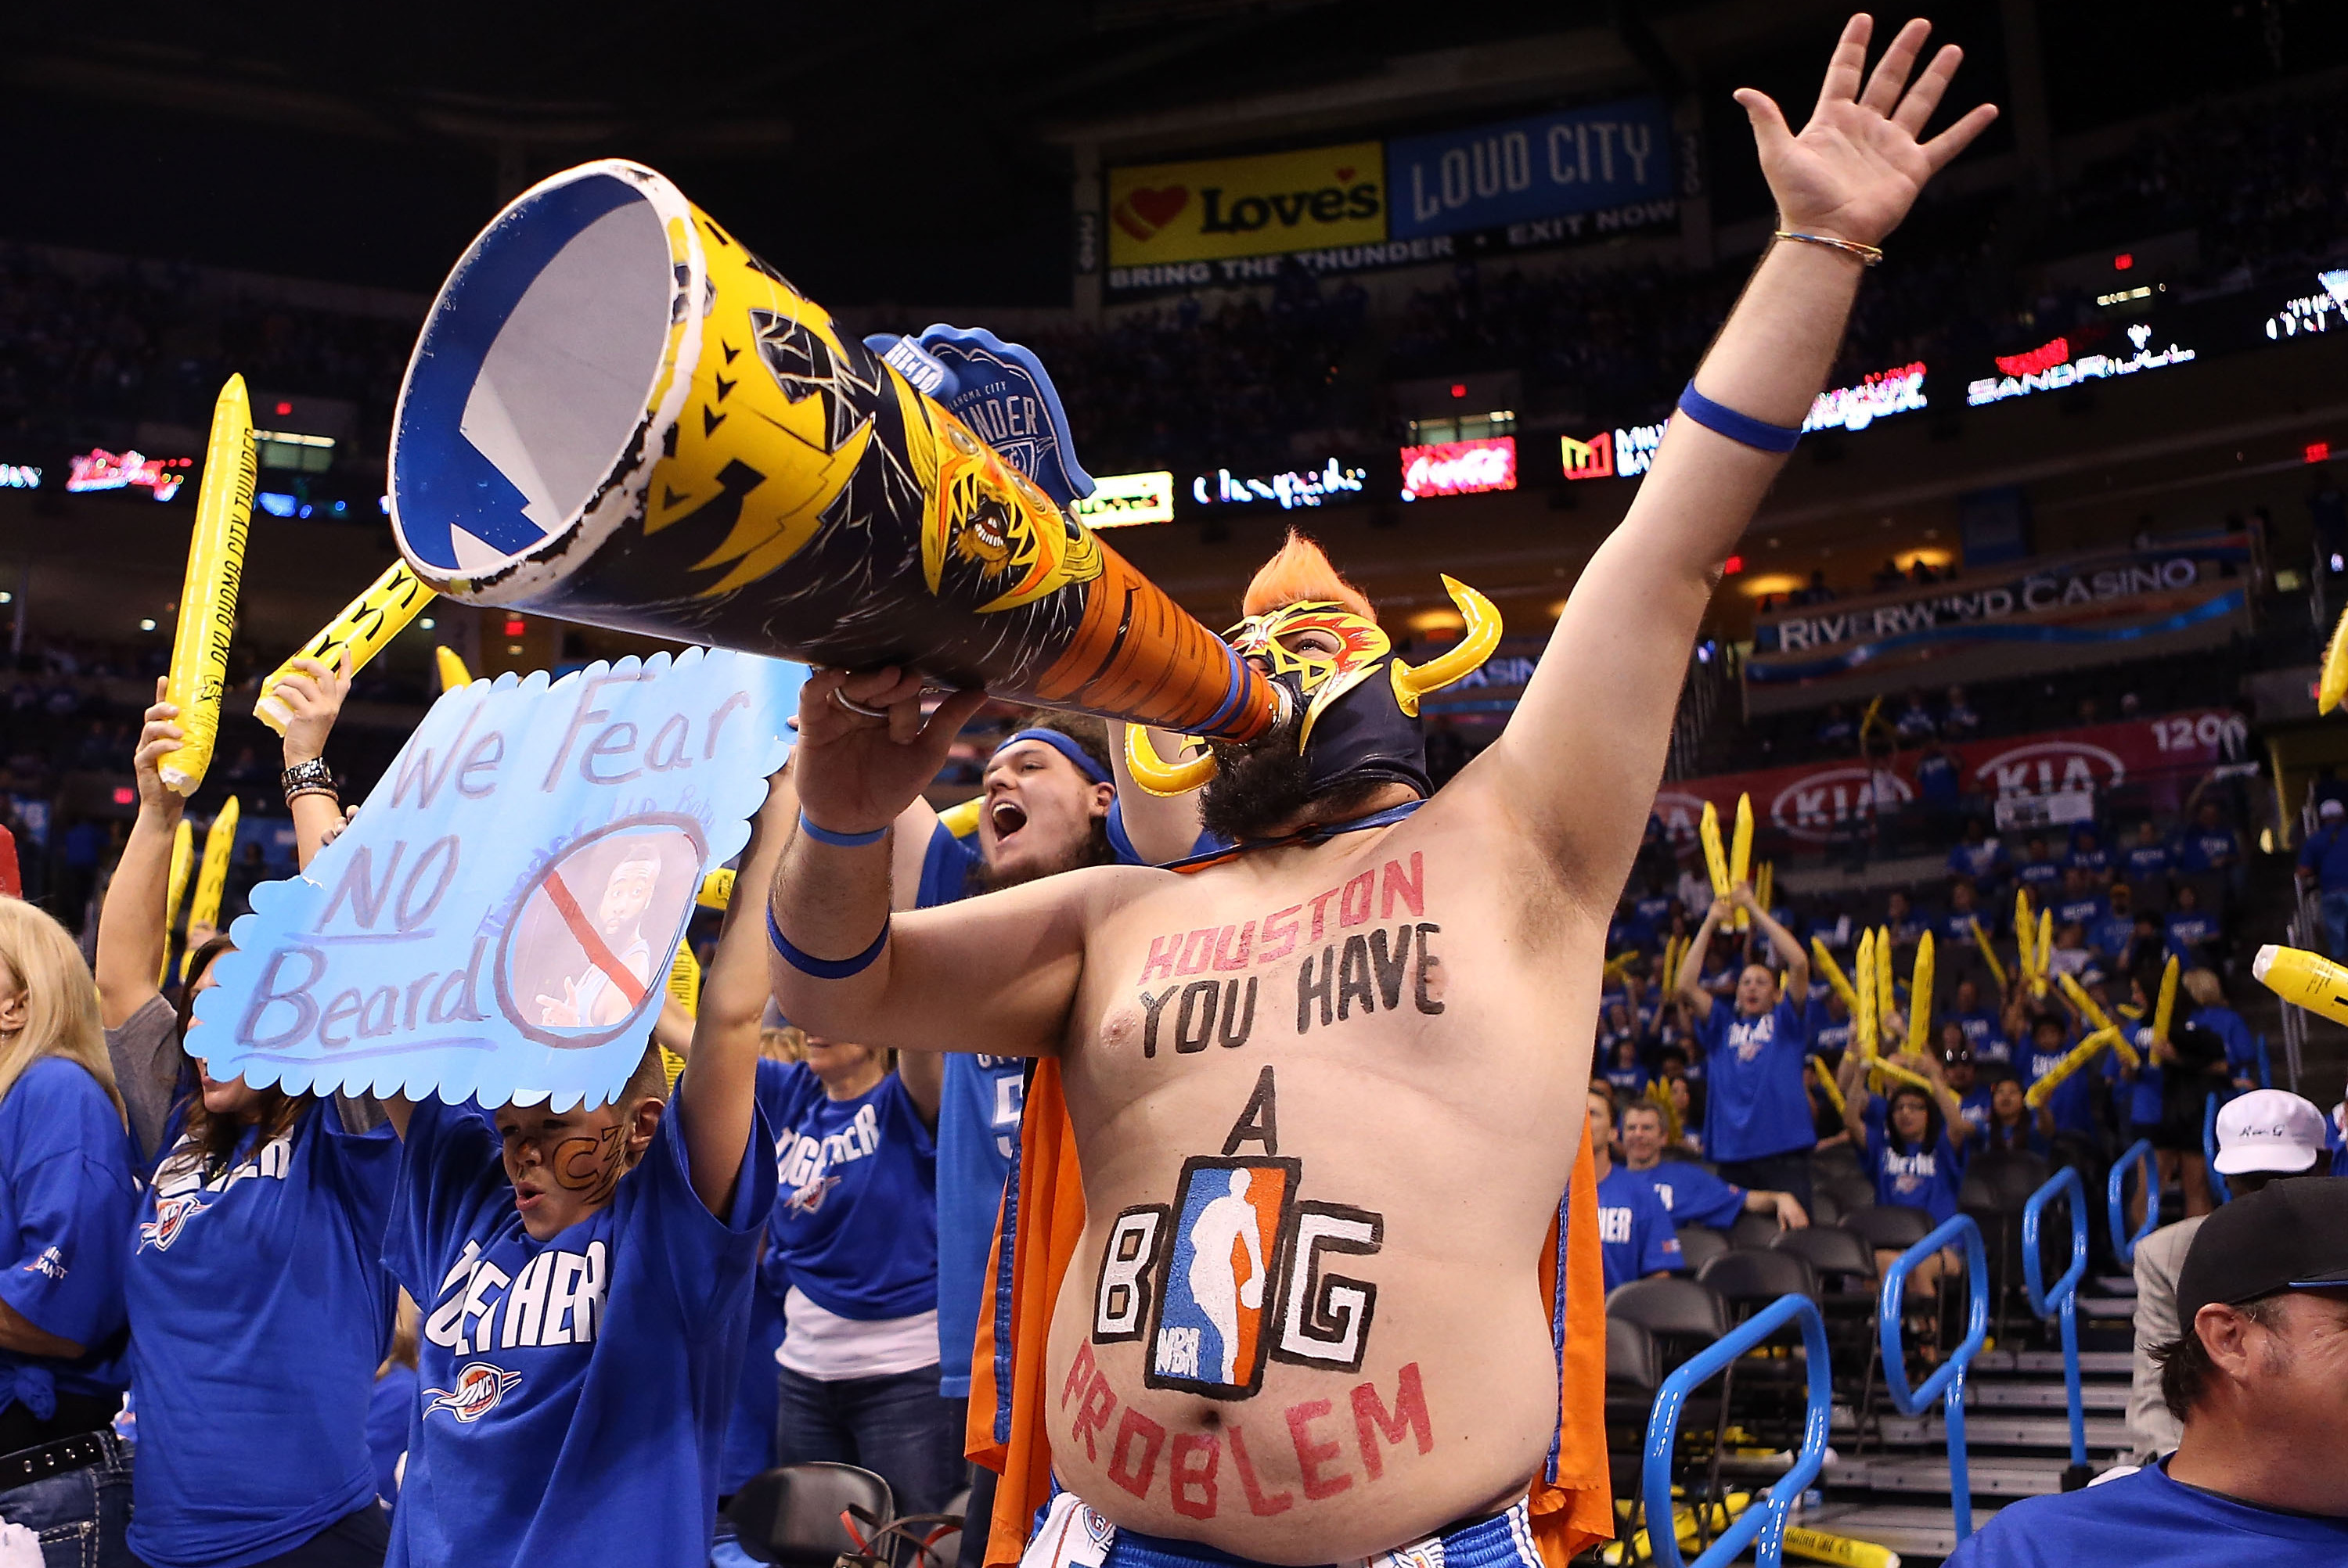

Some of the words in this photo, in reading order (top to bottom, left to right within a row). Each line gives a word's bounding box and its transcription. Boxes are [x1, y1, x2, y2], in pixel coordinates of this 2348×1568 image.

[1412, 131, 1531, 223] LOUD
[1547, 121, 1651, 185] CITY
[1108, 264, 1212, 290] BRING
[1220, 257, 1281, 282] THE
[1295, 236, 1455, 274] THUNDER
[1506, 214, 1585, 246] EXIT
[1594, 198, 1676, 233] NOW
[949, 389, 982, 411] LAHOMA
[985, 380, 1007, 395] CITY
[956, 395, 1039, 443] UNDER
[225, 513, 250, 559] CITY
[2022, 558, 2198, 613] CASINO
[390, 700, 506, 811] We
[542, 671, 753, 793] Fear
[1997, 755, 2097, 797] KIA
[313, 833, 461, 936] NO
[1136, 850, 1425, 987] HOUSTON
[233, 933, 492, 1050] Beard
[1139, 975, 1258, 1059] YOU
[1297, 922, 1446, 1035] HAVE
[1221, 1065, 1277, 1157] A
[1156, 1325, 1200, 1378] NBA
[1061, 1336, 1437, 1521] PROBLEM
